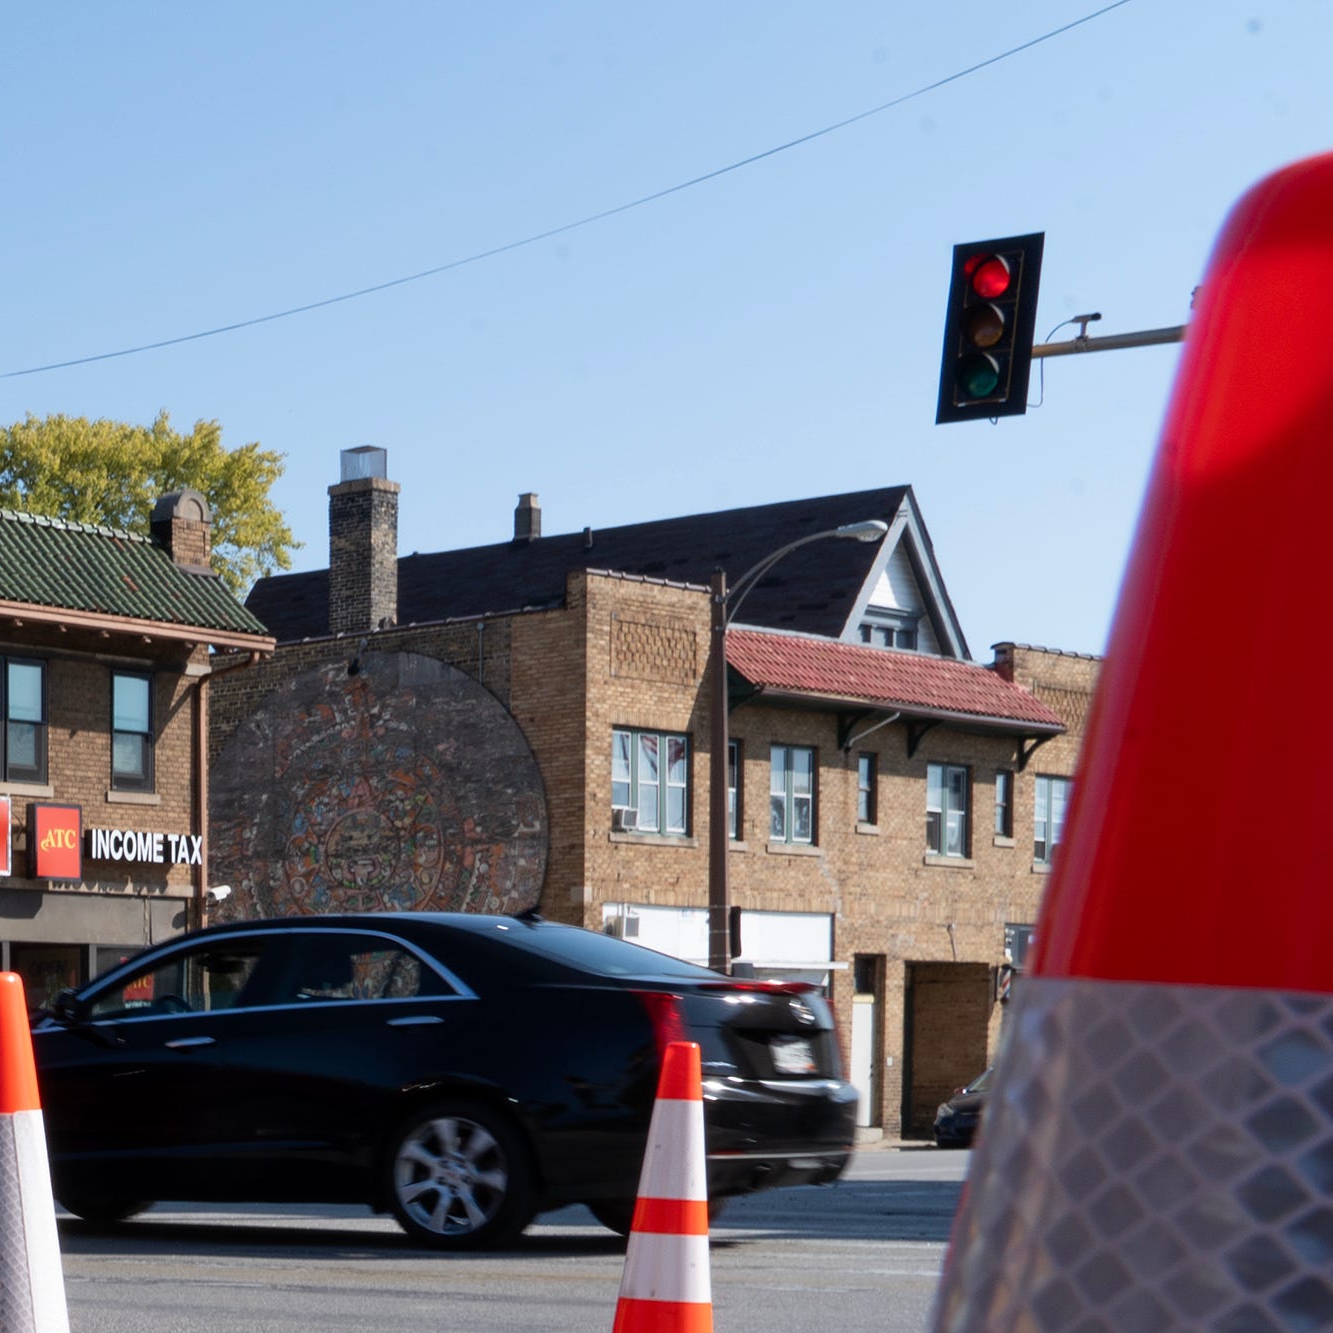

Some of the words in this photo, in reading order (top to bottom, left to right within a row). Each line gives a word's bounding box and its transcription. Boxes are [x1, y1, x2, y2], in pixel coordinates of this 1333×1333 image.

[40, 829, 76, 852] ATC
[91, 828, 164, 863] INCOME
[168, 834, 203, 865] TAX
